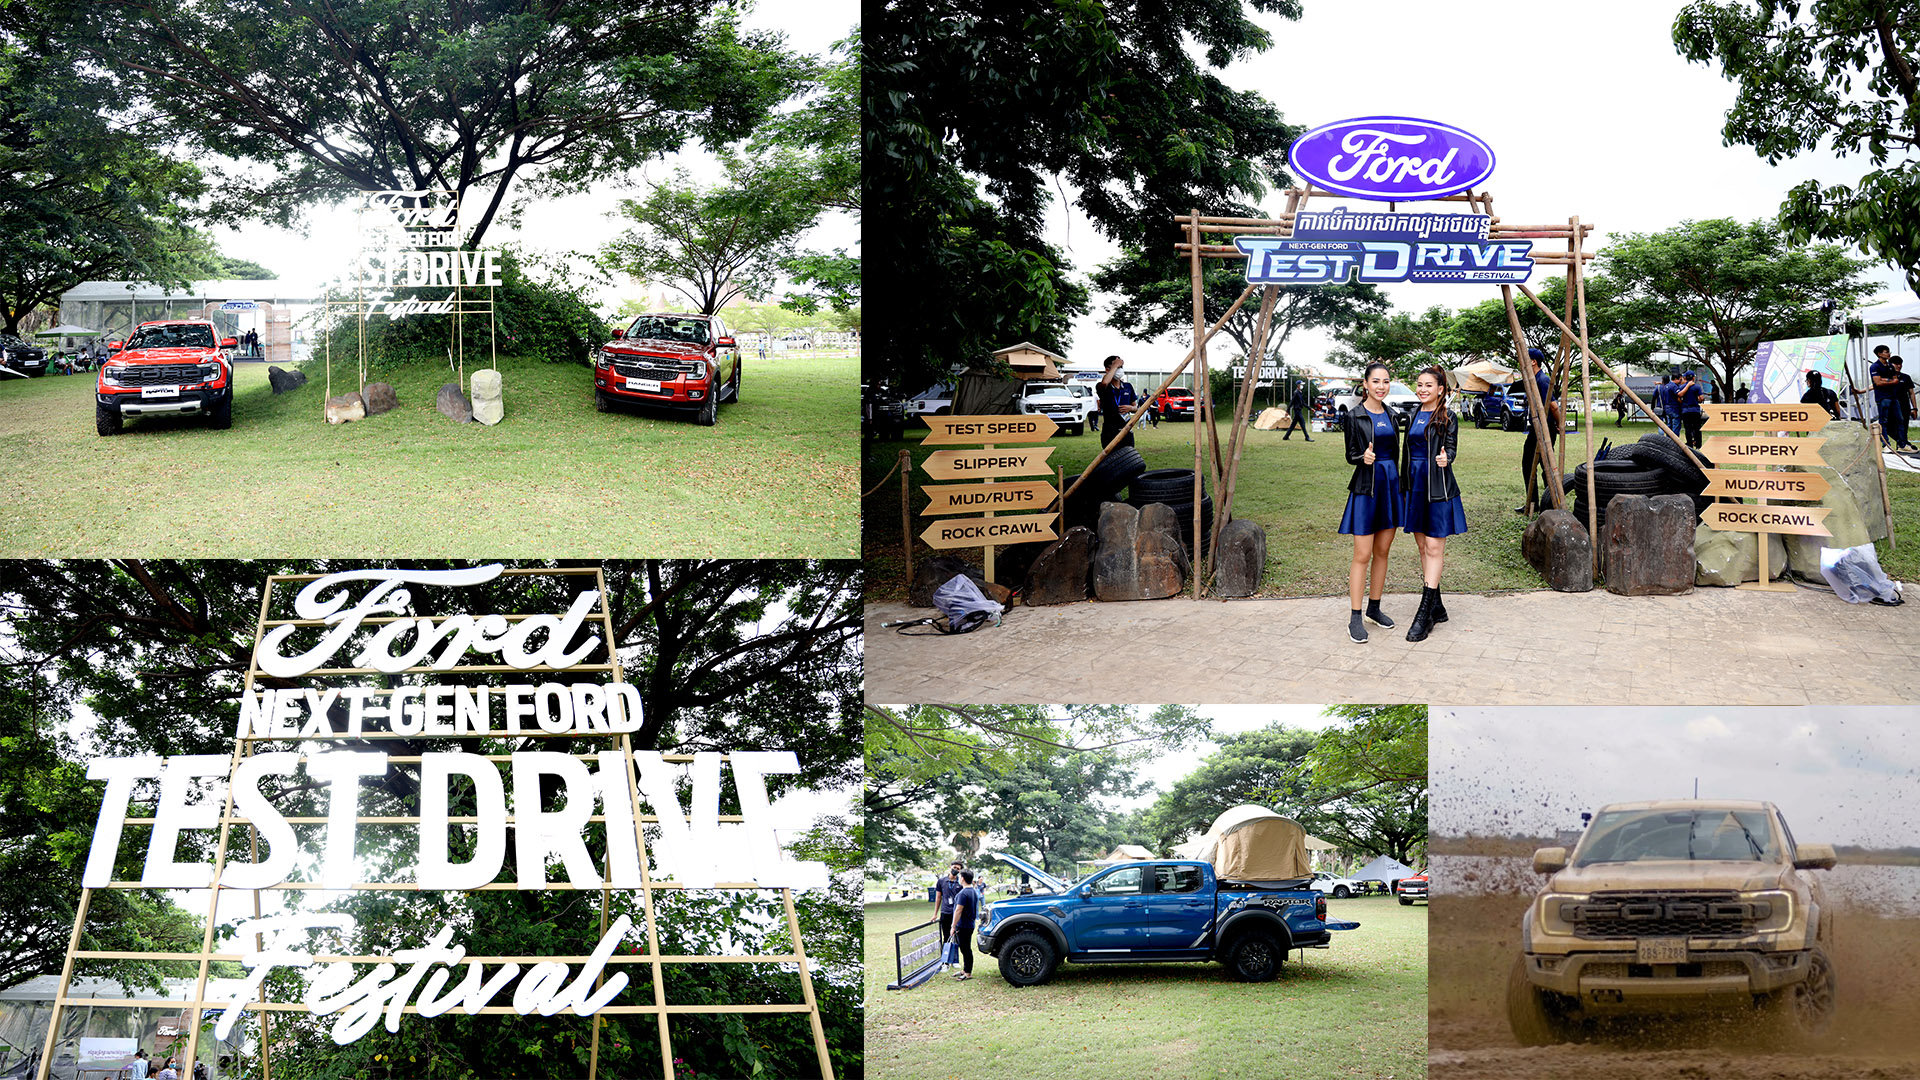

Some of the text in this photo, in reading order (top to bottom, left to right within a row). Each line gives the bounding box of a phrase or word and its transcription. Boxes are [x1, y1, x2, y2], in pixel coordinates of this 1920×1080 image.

[1327, 129, 1459, 185] Ford
[1298, 210, 1491, 240] ការបើកបរសាកល្បងរថយន្ត
[1288, 242, 1349, 250] NEXT-GEN FORD
[1239, 240, 1533, 278] TEST DRIVE
[407, 250, 503, 288] DRIVE
[1472, 271, 1516, 280] FESTIVAL
[364, 291, 457, 321] Festival
[120, 363, 201, 379] FORD
[1258, 366, 1288, 379] DRIVE
[1720, 411, 1809, 422] TEST SPEED
[945, 422, 1037, 435] TEST SPEED
[1728, 445, 1799, 456] SLIPPERY
[953, 456, 1028, 470] SLIPPERY
[1725, 479, 1805, 492] MUD/RUTS
[949, 490, 1034, 506] MUD/RUTS
[1718, 512, 1815, 526] ROCK CRAWL
[941, 522, 1043, 540] ROCK CRAWL
[257, 563, 602, 678] Ford
[236, 682, 645, 741] NEXT-GEN FORD
[81, 749, 831, 891] TEST DRIVE
[1263, 899, 1314, 909] RAPTOR
[1574, 903, 1755, 921] FORD
[213, 912, 631, 1046] Festival
